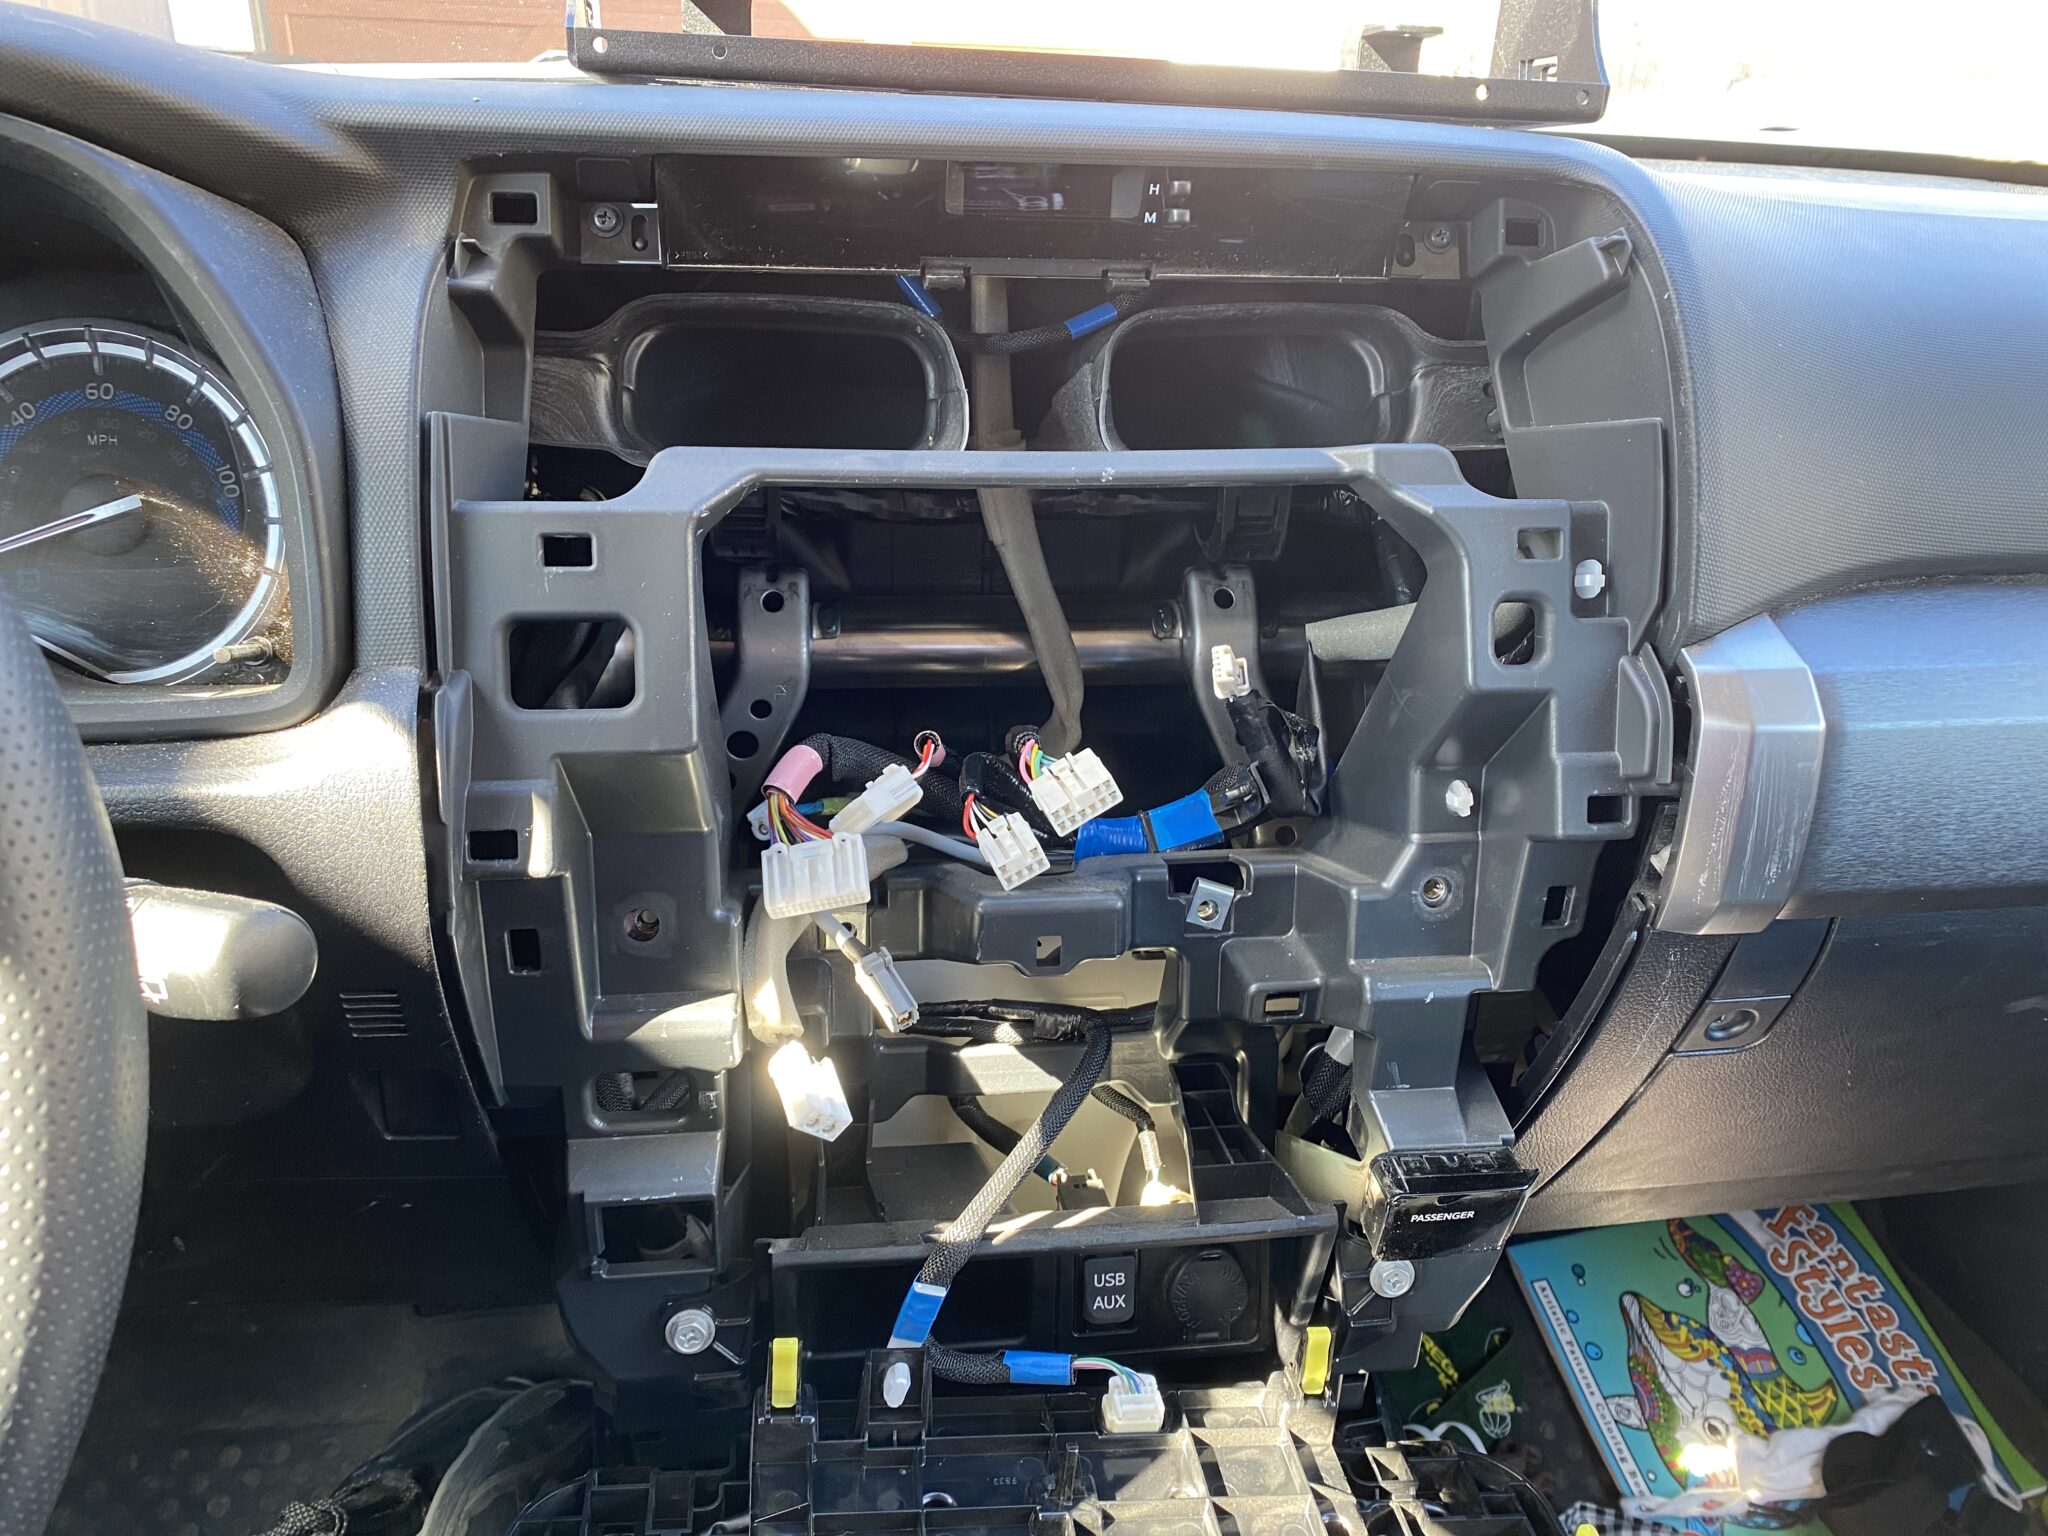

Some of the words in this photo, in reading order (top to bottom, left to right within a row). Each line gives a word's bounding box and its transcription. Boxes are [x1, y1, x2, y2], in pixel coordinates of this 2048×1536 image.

[1149, 183, 1160, 195] H
[1143, 211, 1157, 224] M
[85, 383, 114, 400] 60
[10, 402, 36, 426] 40
[164, 404, 193, 430] 80
[87, 434, 118, 446] MPH
[215, 463, 240, 498] 100
[1410, 1210, 1476, 1223] PASSENGER
[1093, 1272, 1126, 1288] USB
[1093, 1294, 1127, 1310] AUX
[1766, 1204, 1941, 1394] Fantast
[1767, 1238, 1892, 1392] Styles
[1539, 1286, 1567, 1335] Artistic
[1564, 1340, 1596, 1397] Patterns
[1595, 1403, 1629, 1465] Coloring
[1628, 1470, 1646, 1496] Boo
